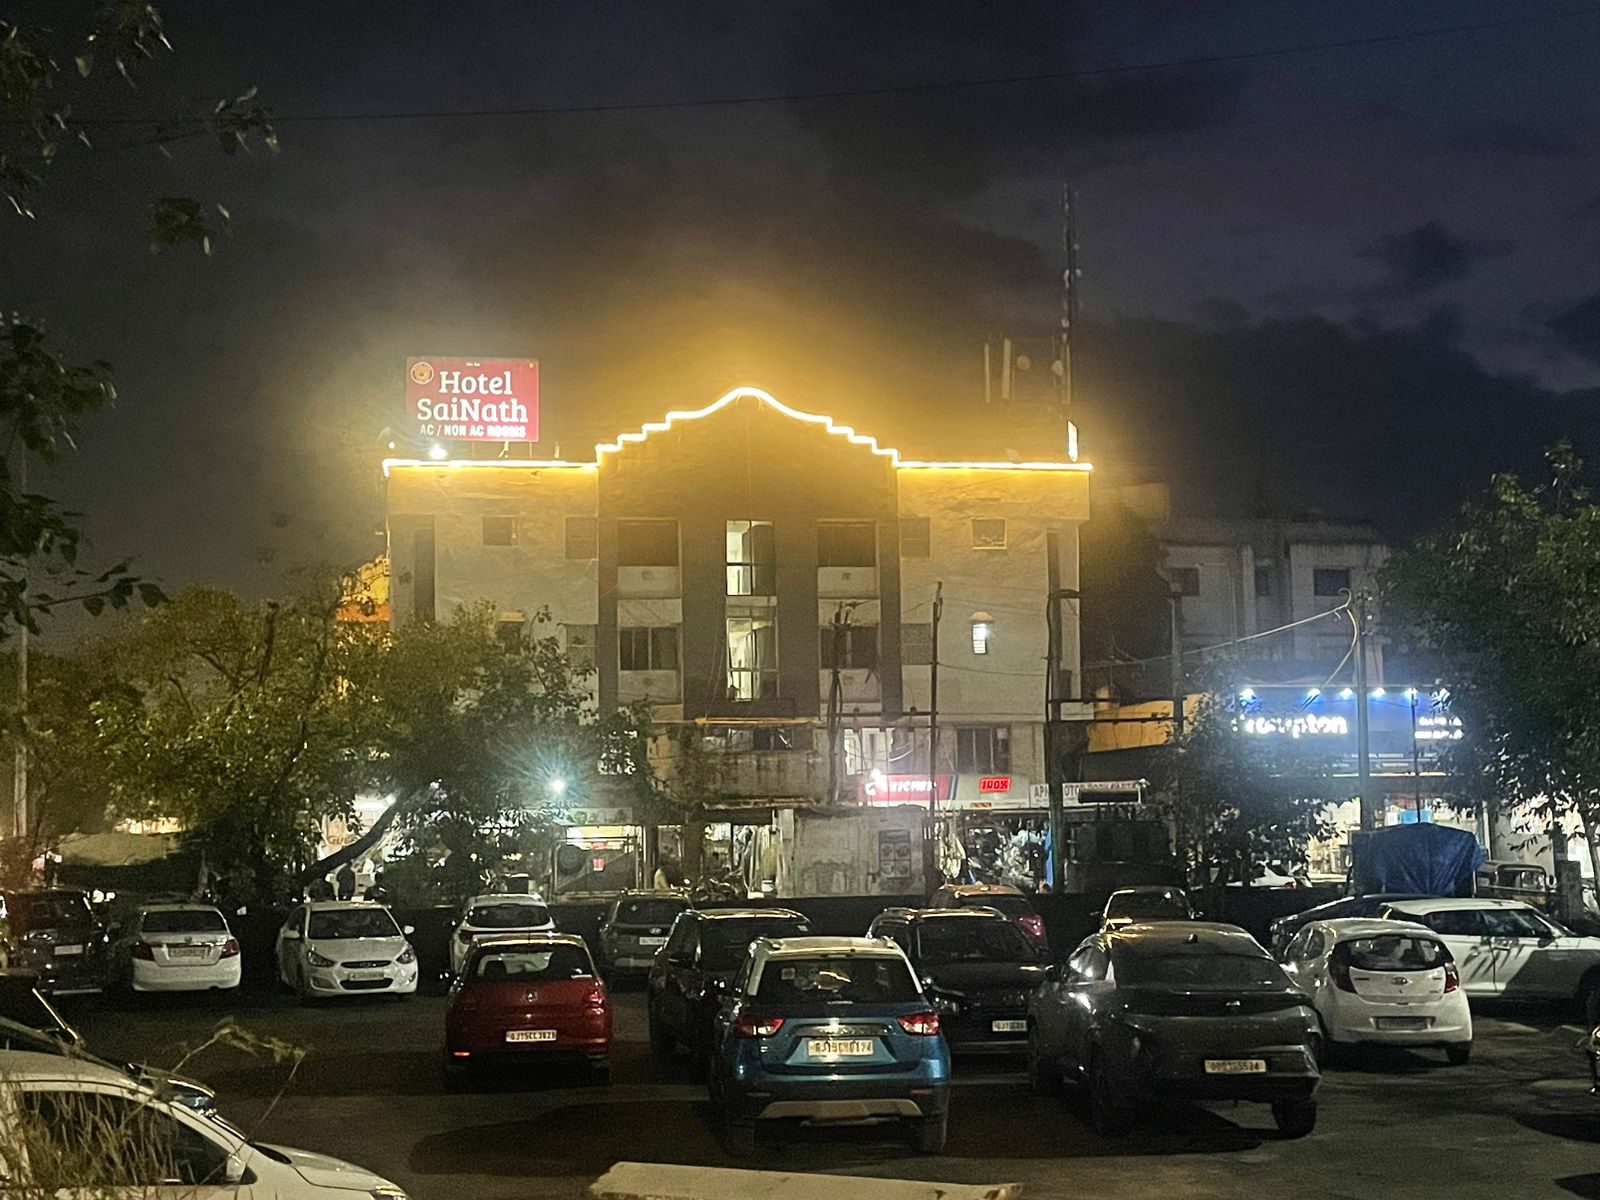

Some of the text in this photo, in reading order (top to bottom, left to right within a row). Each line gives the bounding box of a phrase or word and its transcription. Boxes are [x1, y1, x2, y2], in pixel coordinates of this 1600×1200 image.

[439, 371, 512, 395] Hotel
[416, 397, 528, 422] SaiNath
[420, 425, 434, 435] AC
[444, 425, 467, 436] NON
[470, 425, 483, 437] AC
